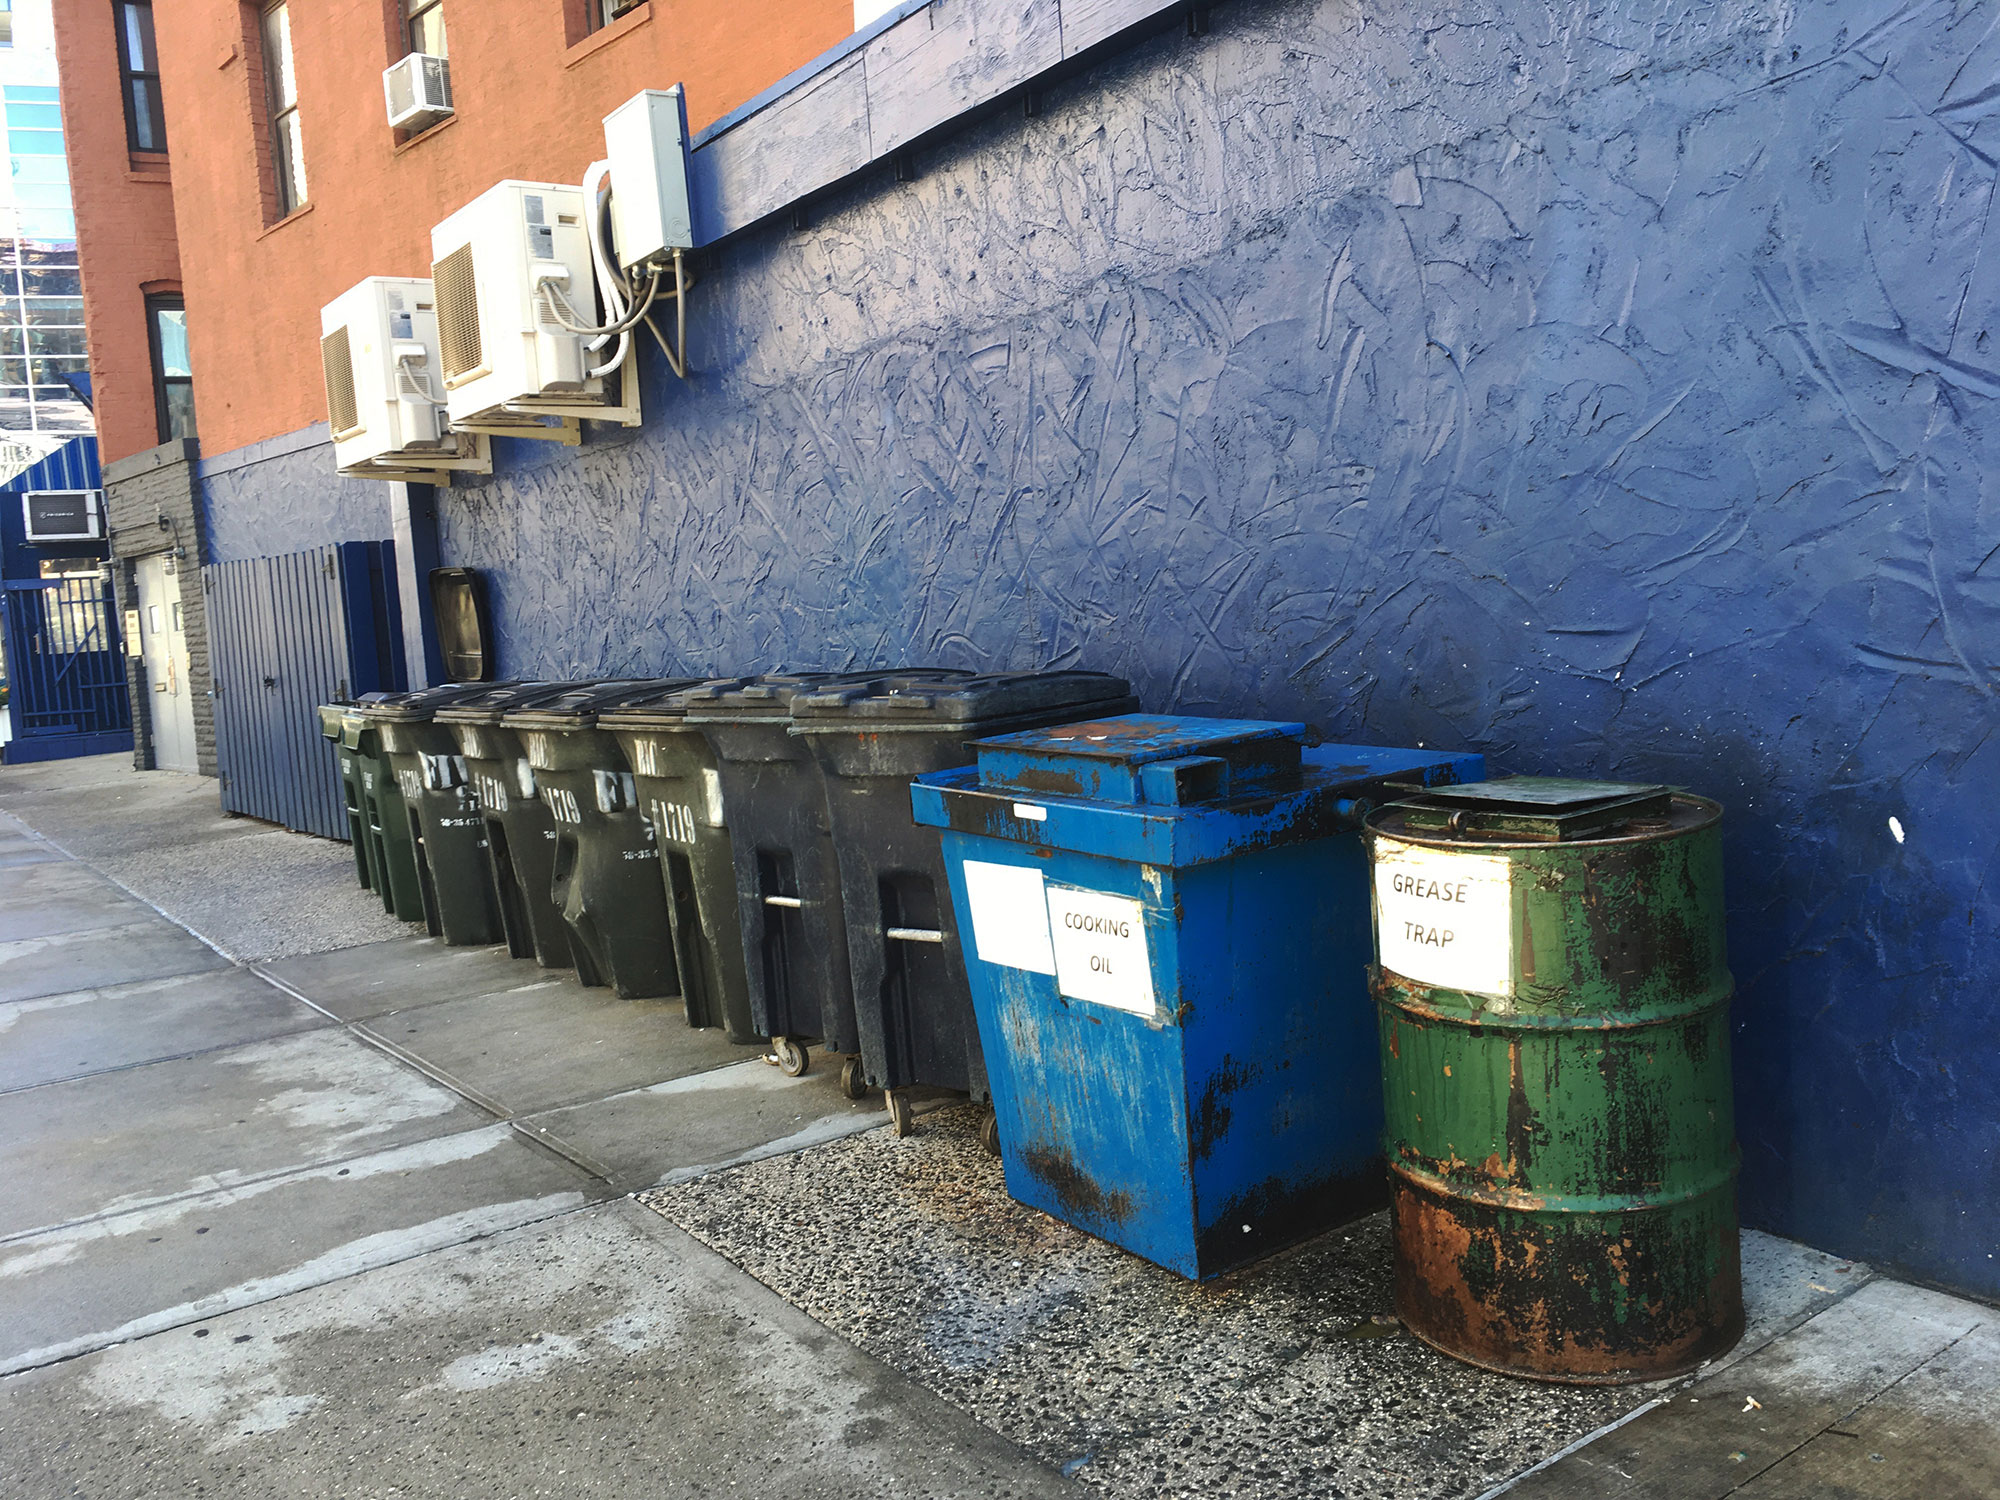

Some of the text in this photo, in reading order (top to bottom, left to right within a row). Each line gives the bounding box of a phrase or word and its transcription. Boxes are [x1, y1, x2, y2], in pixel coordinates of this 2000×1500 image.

[1393, 873, 1468, 904] GREASE
[1065, 912, 1129, 938] COOKING
[1404, 921, 1455, 948] TRAP
[1090, 955, 1112, 975] OIL
